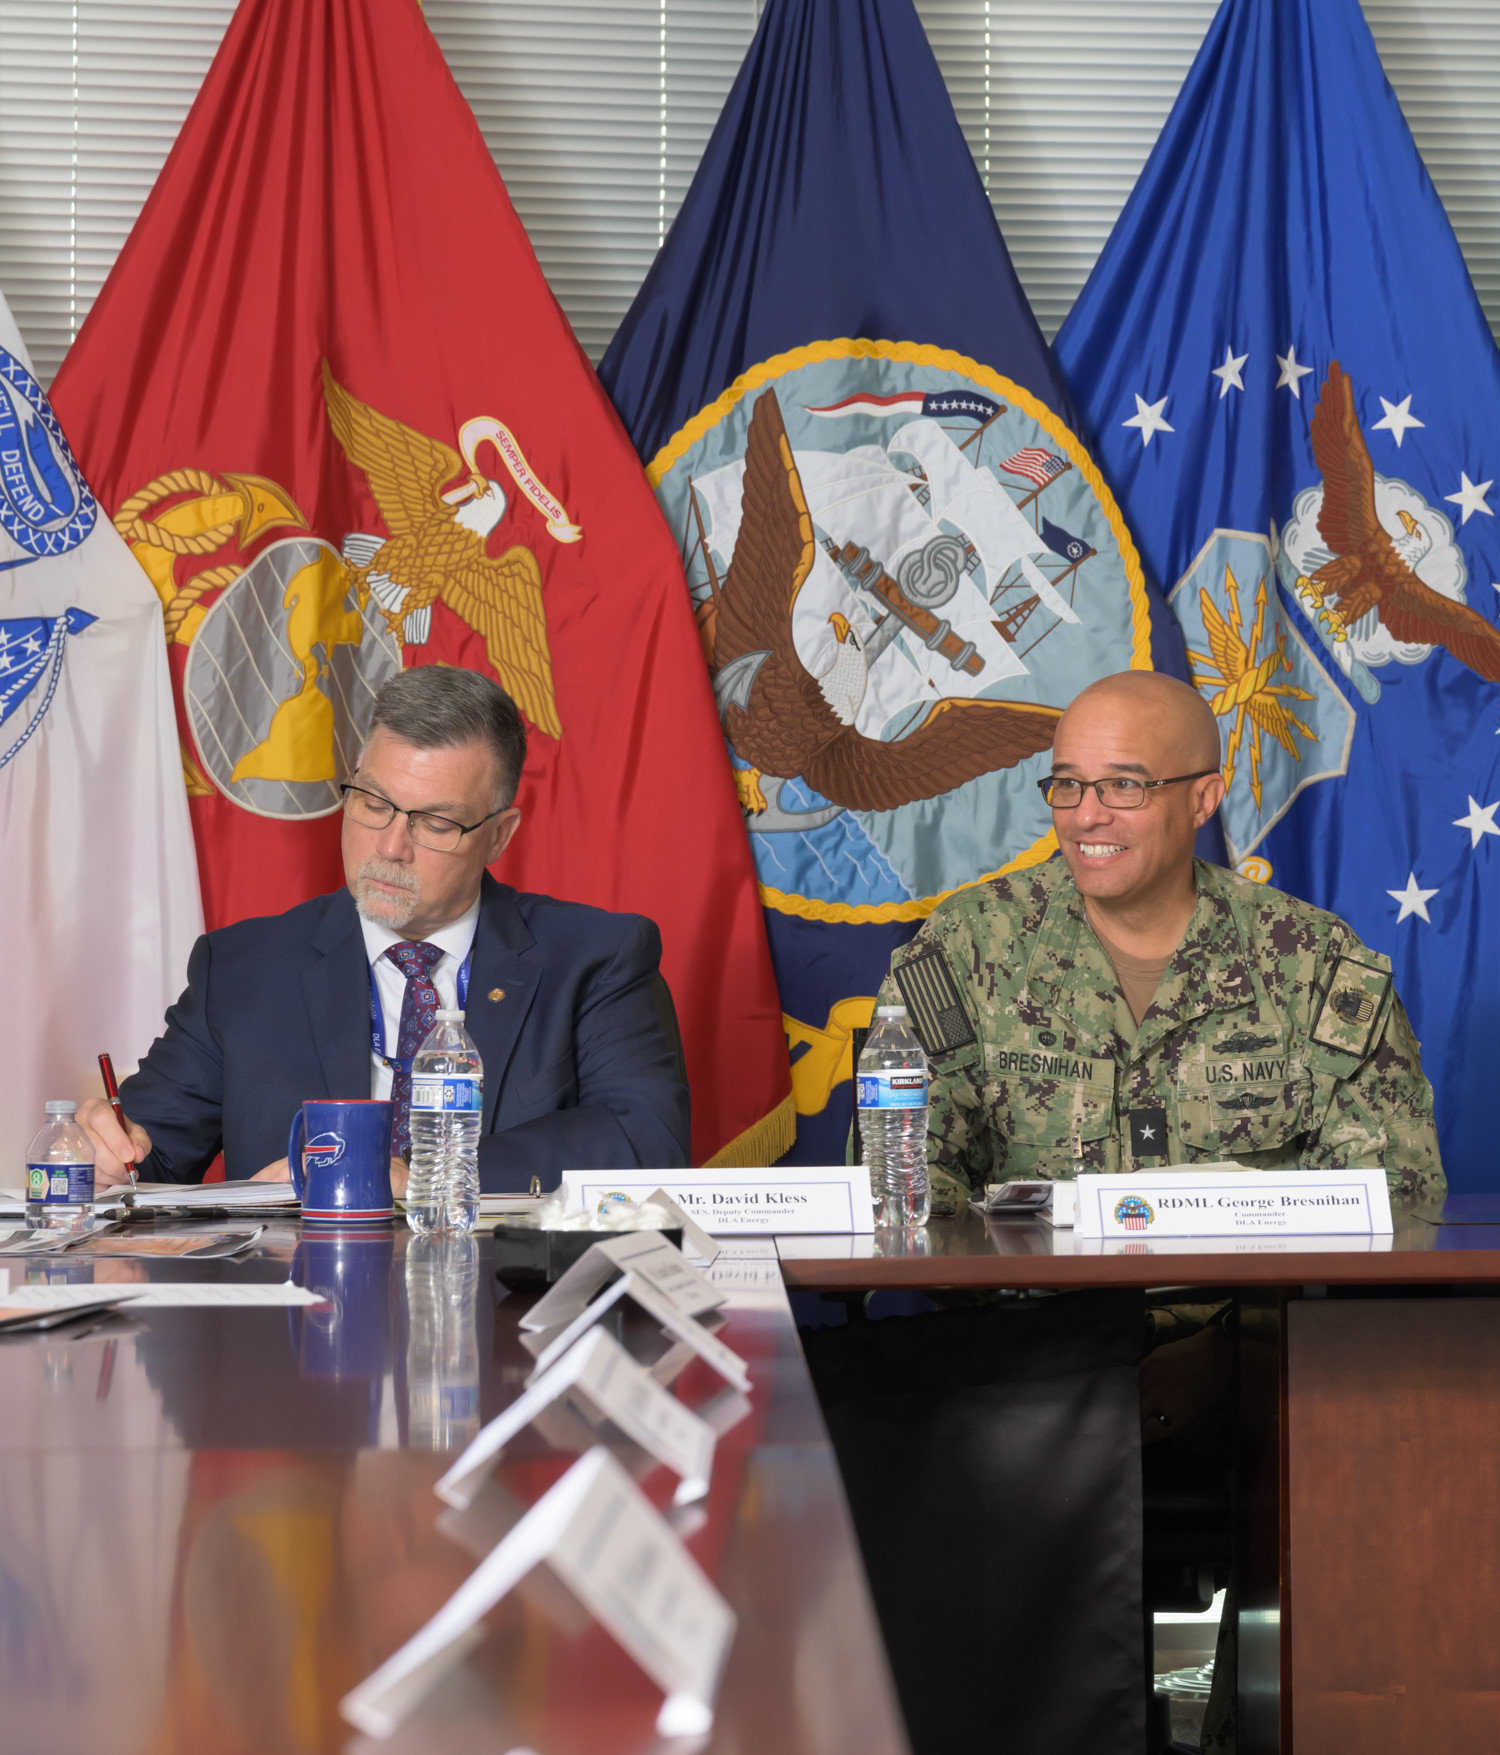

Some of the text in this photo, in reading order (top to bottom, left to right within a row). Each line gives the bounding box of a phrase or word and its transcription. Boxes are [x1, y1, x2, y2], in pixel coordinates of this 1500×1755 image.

[496, 430, 561, 519] SEMPER FIDELIS
[2, 449, 45, 521] DEFEND
[999, 1050, 1093, 1080] BRESNIHAN
[1205, 1060, 1285, 1084] U.S. NAVY
[678, 1192, 807, 1205] Mr. David Kless
[1158, 1195, 1360, 1210] RDML George Bresnihan
[712, 1208, 742, 1216] Deputy
[744, 1207, 795, 1215] Commander
[740, 1217, 769, 1225] Energy
[1258, 1219, 1287, 1227] Energy
